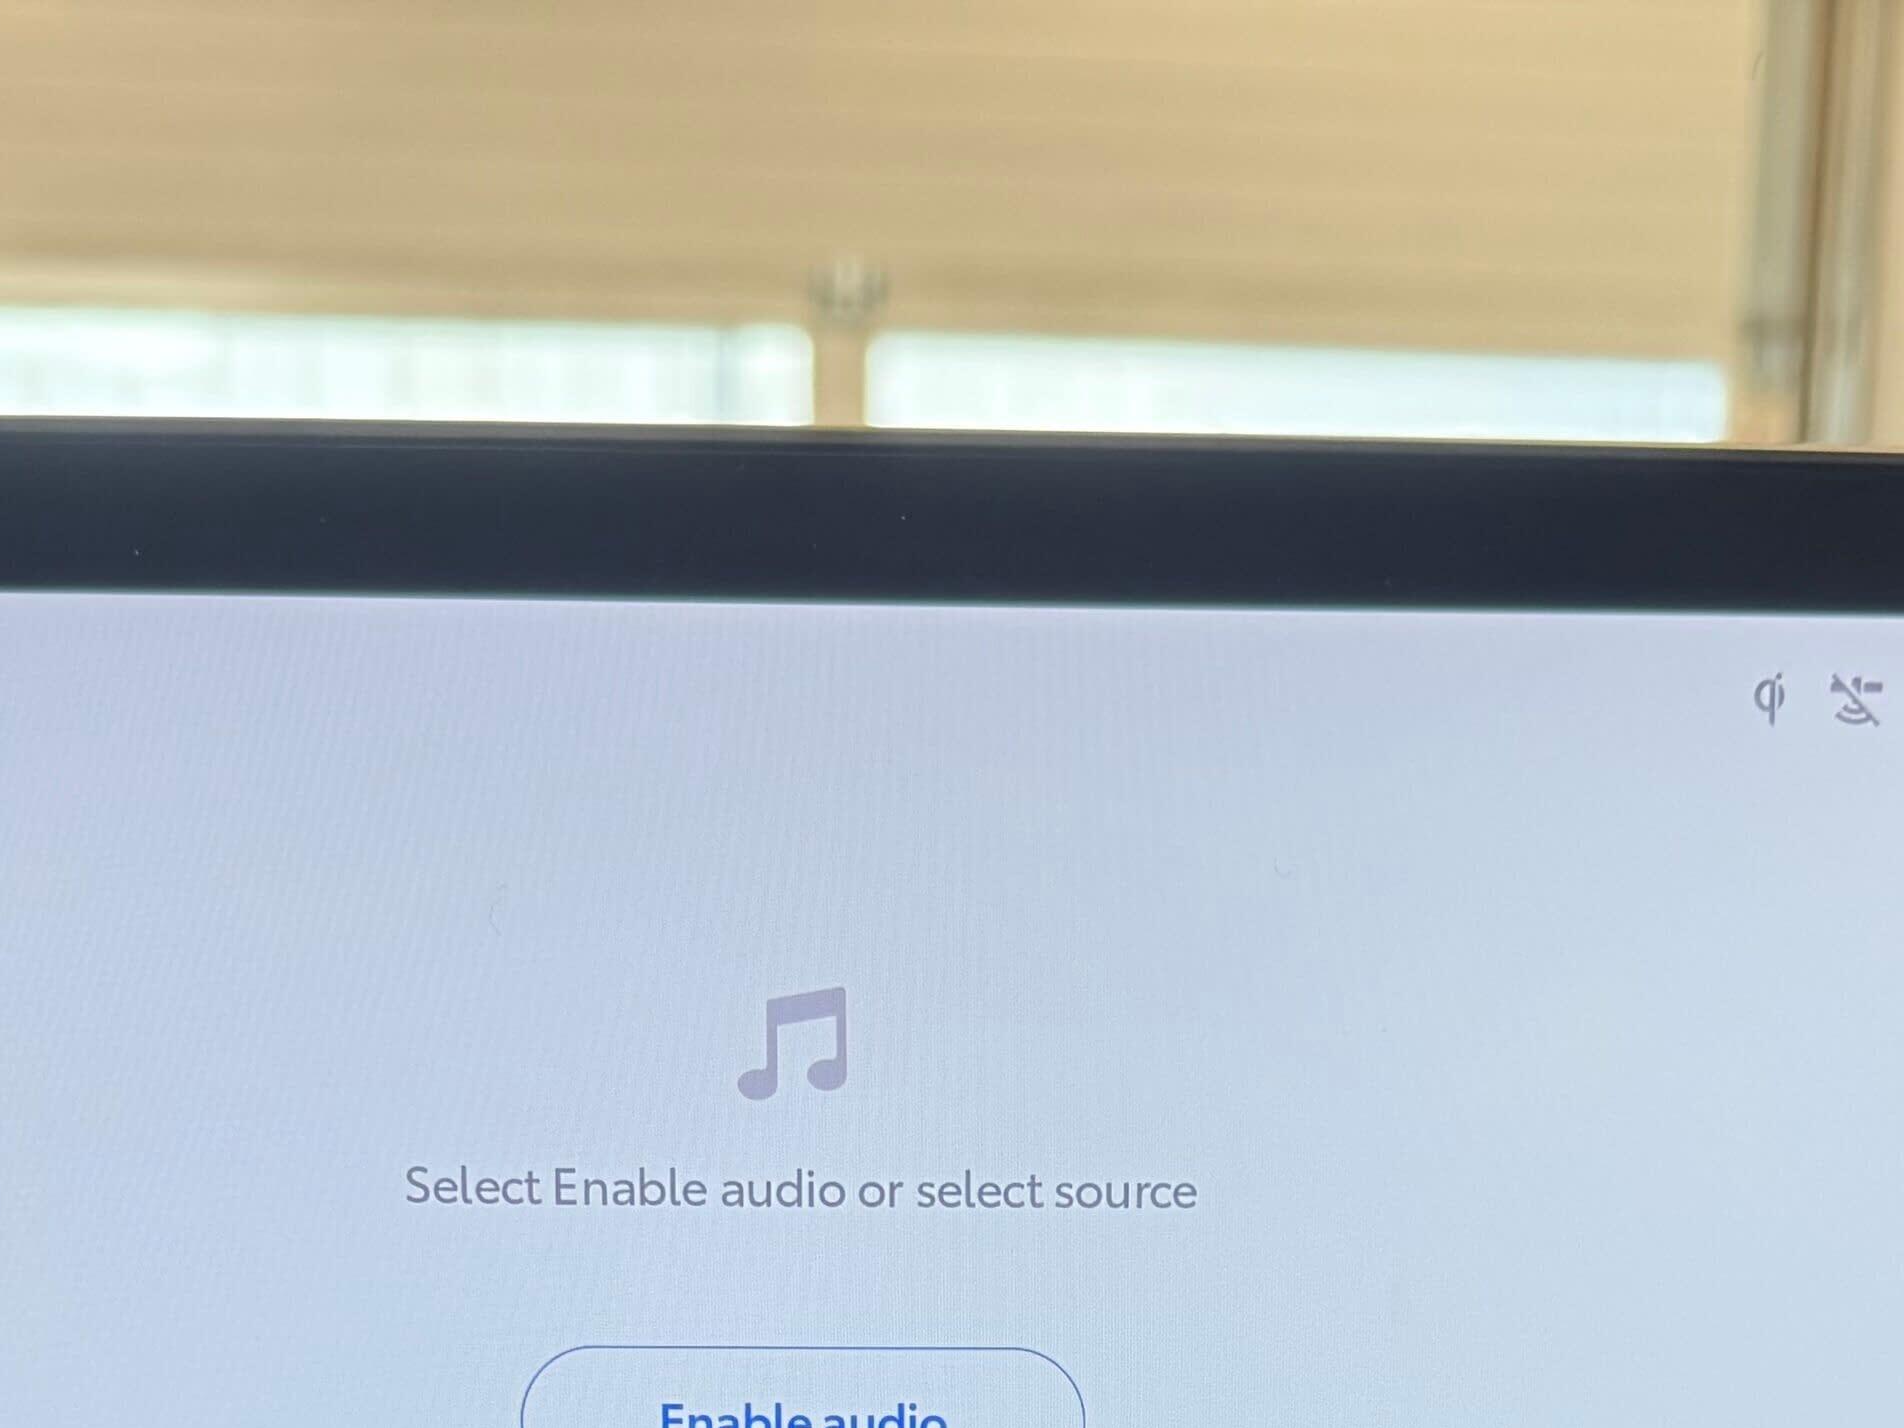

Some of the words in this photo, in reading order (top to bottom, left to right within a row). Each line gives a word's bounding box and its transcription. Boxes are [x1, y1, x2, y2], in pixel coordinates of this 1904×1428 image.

[405, 1164, 543, 1206] Select
[553, 1166, 708, 1207] Enable
[721, 1167, 846, 1208] audio
[858, 1181, 904, 1209] or
[917, 1169, 1045, 1210] select
[1055, 1182, 1198, 1210] source
